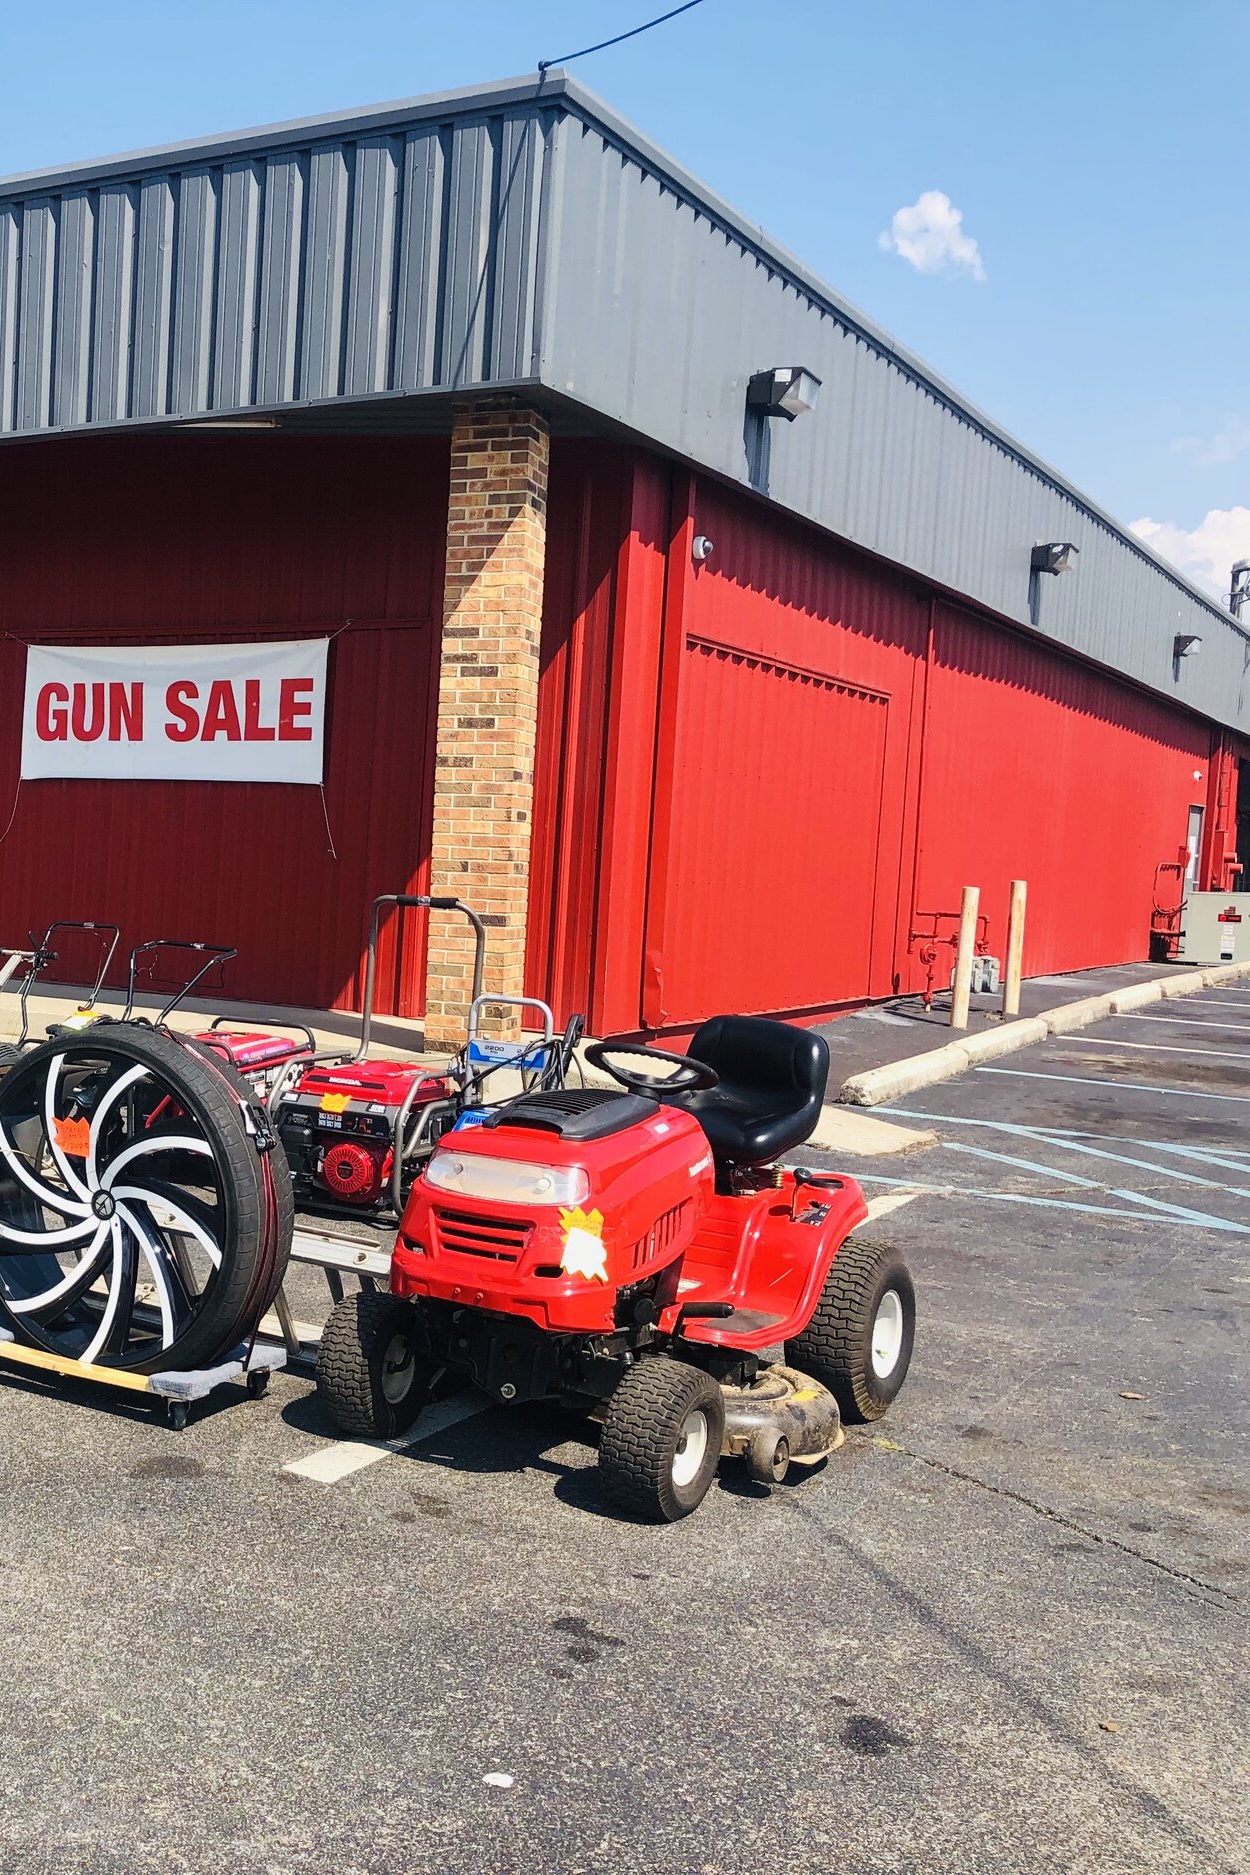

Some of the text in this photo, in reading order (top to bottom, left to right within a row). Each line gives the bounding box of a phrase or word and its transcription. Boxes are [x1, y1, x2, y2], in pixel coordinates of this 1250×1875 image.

[36, 678, 314, 742] GUN SALE
[328, 1076, 362, 1086] HONDA
